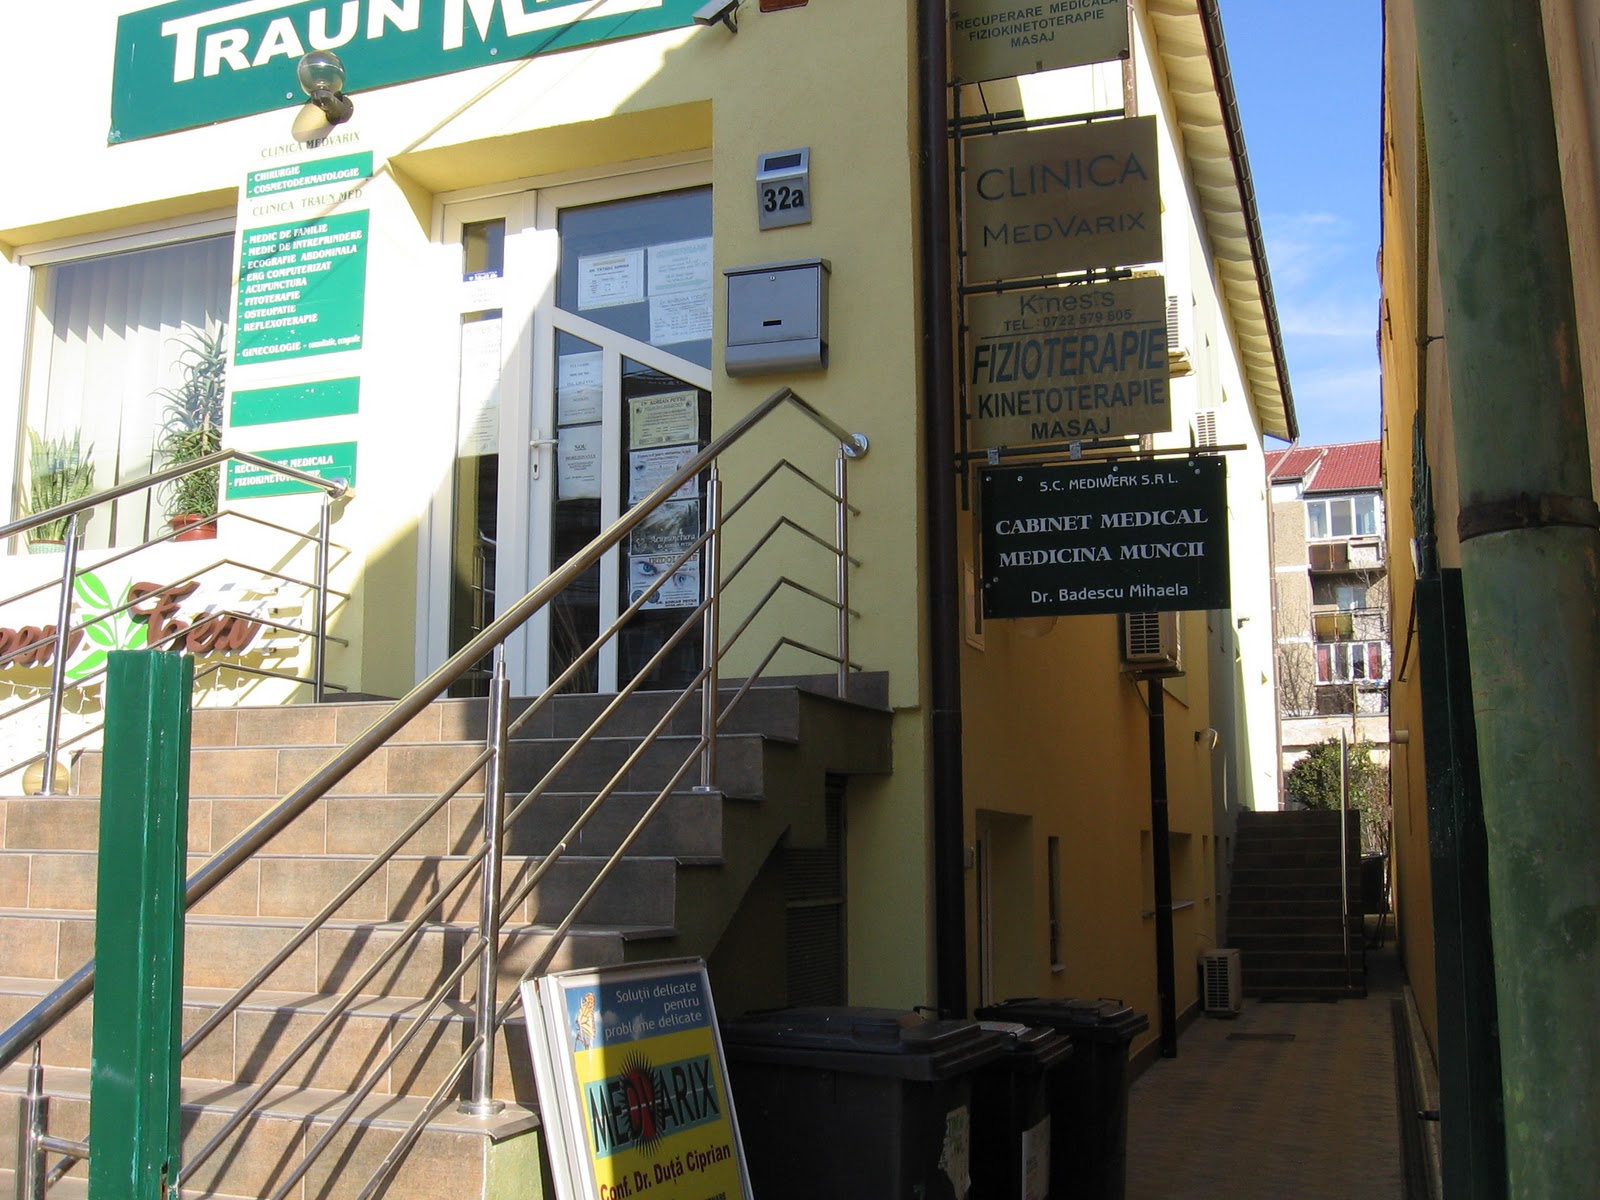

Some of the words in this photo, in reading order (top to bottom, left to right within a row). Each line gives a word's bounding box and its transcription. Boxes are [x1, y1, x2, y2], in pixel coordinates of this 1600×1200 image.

[955, 5, 1043, 31] RECUPERARE
[1049, 0, 1119, 14] MEDICA
[969, 8, 1104, 42] FIZIOKINETOTERAPIE
[161, 0, 420, 83] TRAUN
[1010, 31, 1055, 48] MASAJ
[261, 142, 302, 158] CLINICA
[254, 166, 300, 182] CHIRURGIE
[254, 167, 360, 194] COSMETODERMATOLOGIE
[976, 152, 1148, 201] CLINICA
[252, 201, 294, 217] CLINICA
[301, 195, 335, 208] TRAUN
[339, 188, 363, 201] MED
[764, 186, 804, 212] 32a
[248, 244, 277, 257] MEDIC
[278, 241, 291, 252] DE
[292, 229, 362, 250] INTREPRINDERE
[249, 231, 278, 244] MEDIC
[279, 229, 291, 240] DE
[293, 223, 328, 237] FAMILIE
[247, 254, 297, 270] ECOGRAFIE
[300, 244, 358, 262] ABDOMINALA
[246, 273, 265, 283] EKG
[266, 261, 332, 280] COMPUTERIZAT
[244, 290, 301, 307] FITOTERAPIE
[245, 277, 307, 295] ACUPUNCTURA
[243, 313, 318, 332] REFLEXOTERAPIE
[242, 341, 302, 357] GINECOLOGIE
[971, 327, 1167, 385] FIZIOTERAPIE
[978, 378, 1165, 420] KINETOTERAPIE
[1031, 416, 1111, 440] MASAJ
[290, 455, 334, 468] MEDICALA
[1039, 480, 1065, 492] S.C.
[1069, 475, 1138, 490] MEDIWERK
[995, 514, 1092, 536] CABINET
[1100, 508, 1209, 529] MEDICAL
[999, 546, 1112, 568] MEDICINA
[1119, 541, 1205, 561] MUNCII
[1031, 590, 1053, 604] Dr.
[1059, 586, 1124, 601] Badescu
[1129, 583, 1189, 598] Mihaela
[653, 982, 697, 998] delicate
[663, 997, 700, 1014] pentru
[604, 1020, 656, 1041] probleme
[658, 1011, 702, 1028] delicate
[600, 1175, 632, 1200] Conf.
[633, 1171, 652, 1193] Dr.
[686, 1144, 731, 1173] Ciprian
